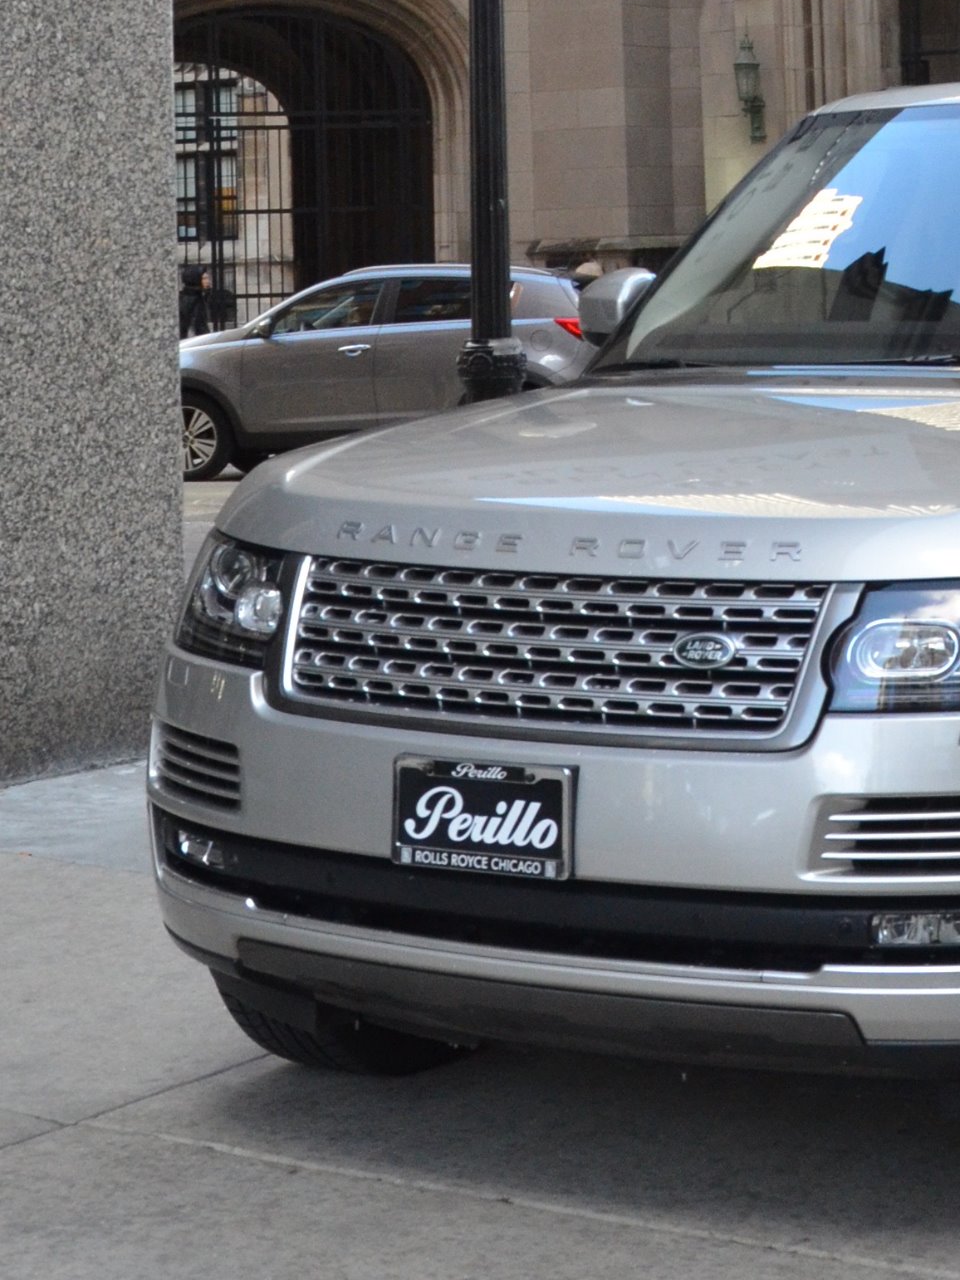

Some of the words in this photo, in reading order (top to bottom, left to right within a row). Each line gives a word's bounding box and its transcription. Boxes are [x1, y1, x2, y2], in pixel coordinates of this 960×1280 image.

[336, 520, 523, 554] RANGE
[568, 537, 803, 562] ROVER
[686, 641, 715, 650] LAND
[687, 650, 723, 660] ROVER
[451, 763, 507, 780] Perillo
[404, 786, 558, 849] Perillo
[415, 850, 448, 866] ROLLS
[450, 854, 488, 870] ROYCE
[491, 858, 541, 875] CHICAGO
